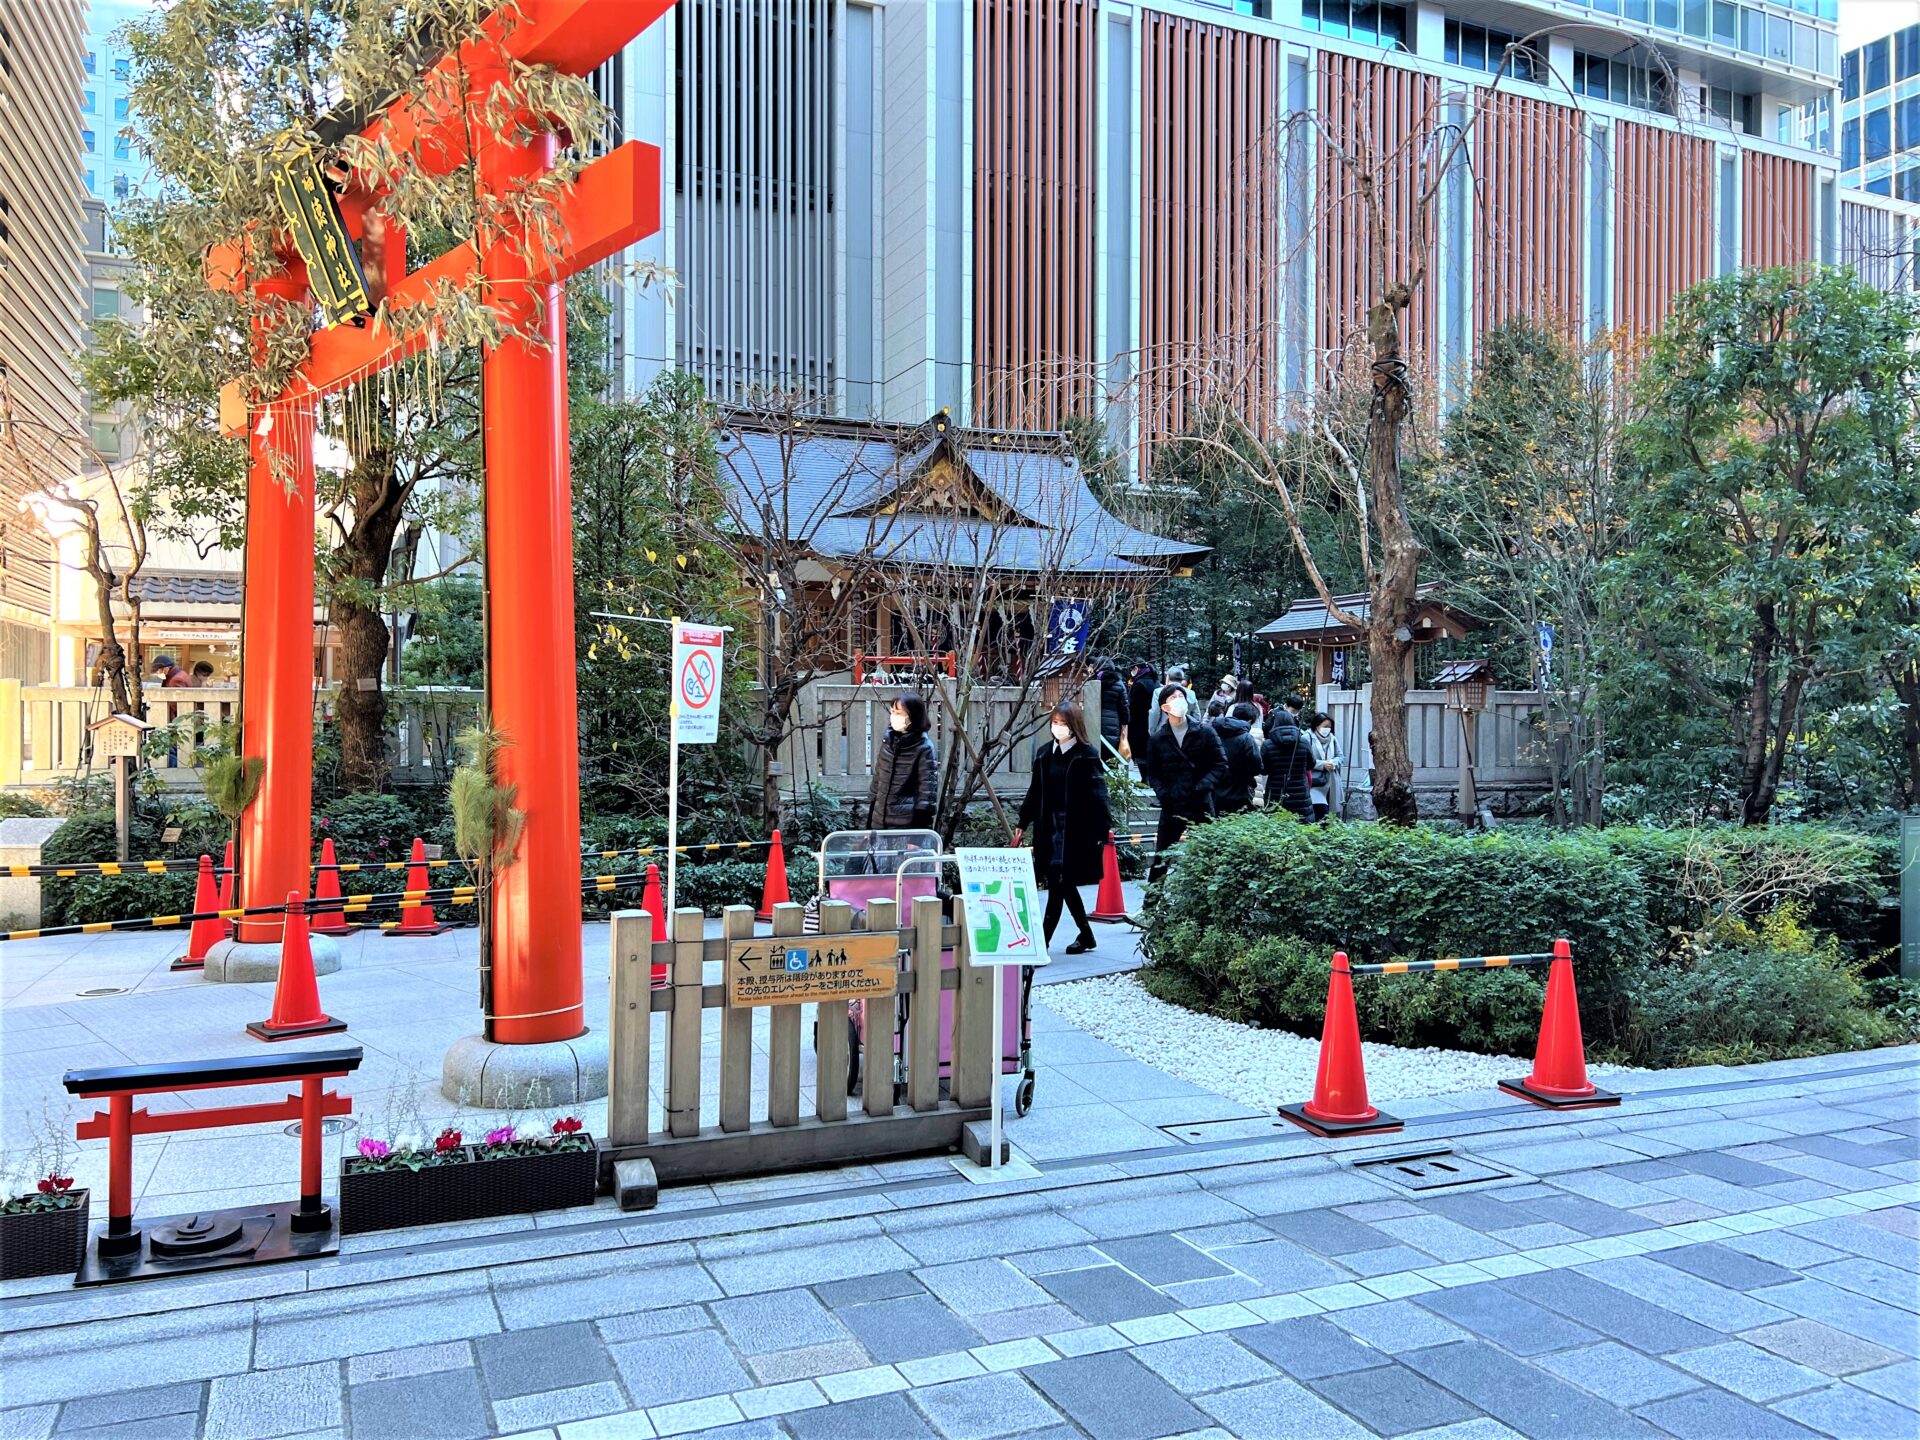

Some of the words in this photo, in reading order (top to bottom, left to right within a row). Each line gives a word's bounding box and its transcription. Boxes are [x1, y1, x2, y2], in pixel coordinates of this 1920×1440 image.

[737, 969, 864, 986] 本殿、授与所は階段がありますので
[737, 979, 881, 996] この先のエレベーターをご利用ください
